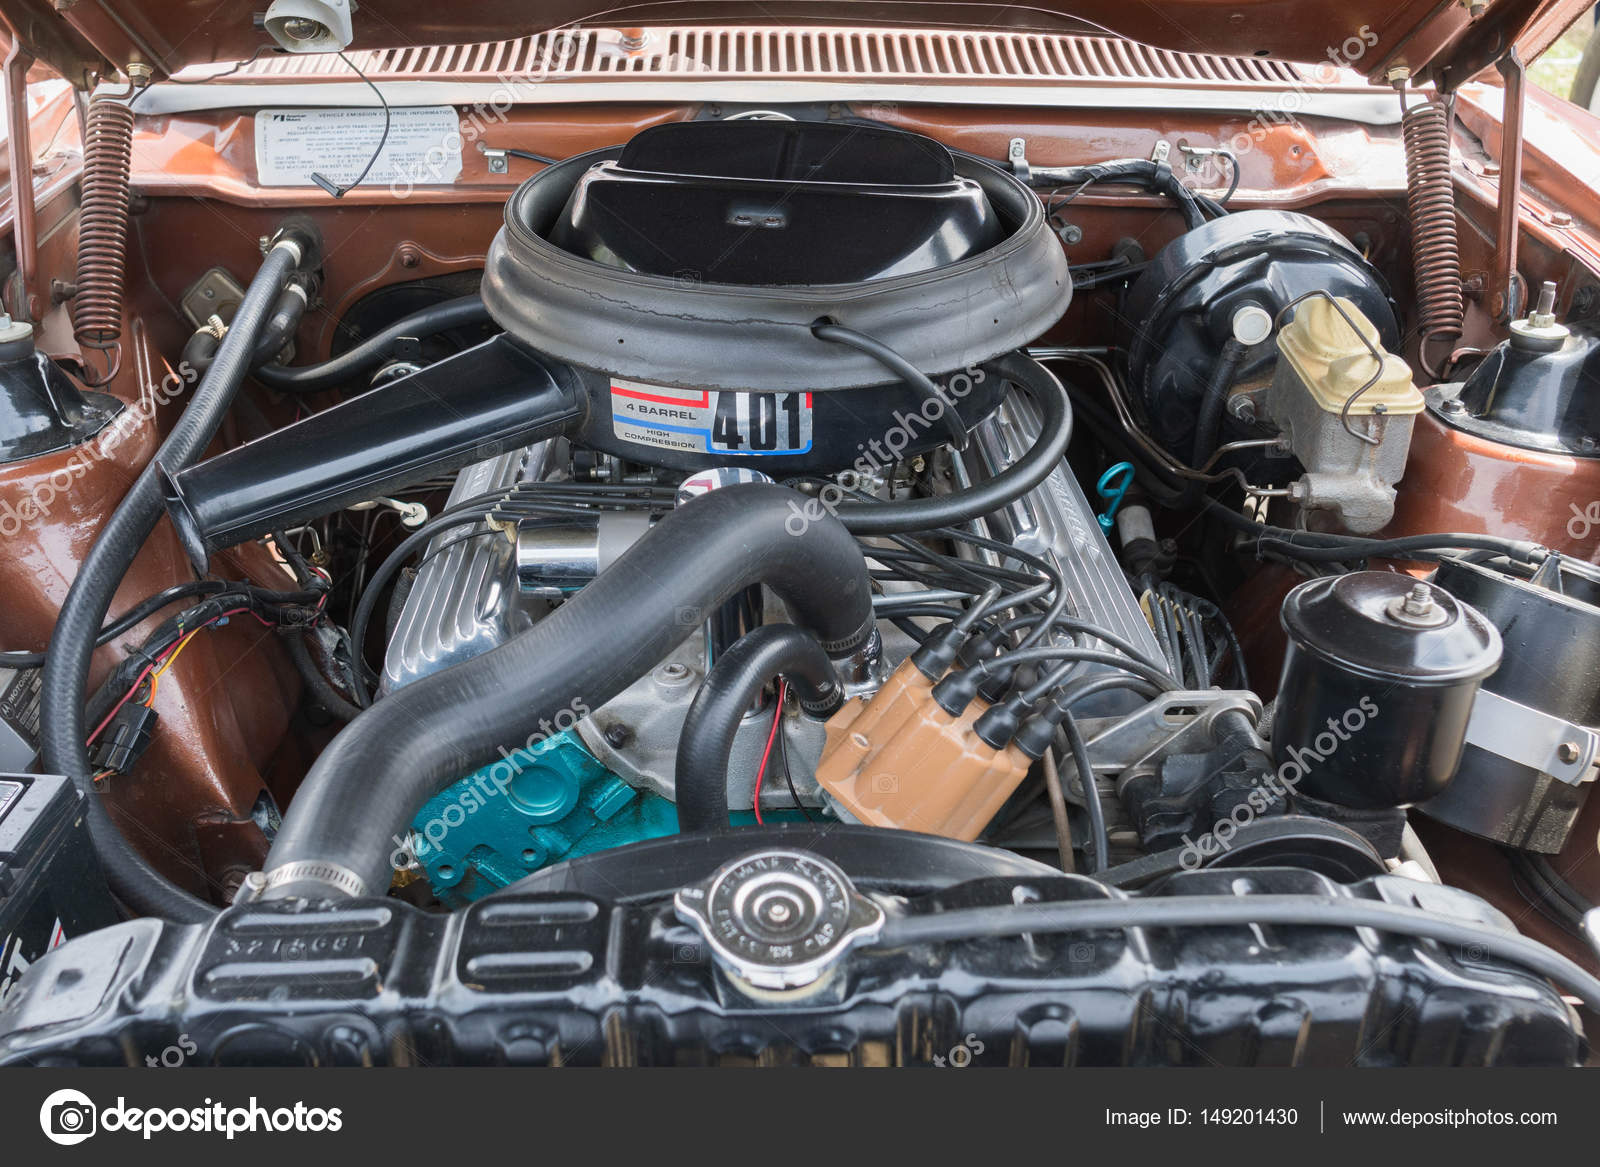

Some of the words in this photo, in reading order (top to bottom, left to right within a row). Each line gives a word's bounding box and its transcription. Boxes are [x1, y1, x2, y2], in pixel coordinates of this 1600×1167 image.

[626, 403, 635, 412] 4
[638, 405, 698, 421] BARREL
[712, 392, 800, 450] 401
[624, 432, 696, 449] COMPRESSION
[646, 429, 670, 438] HIGH
